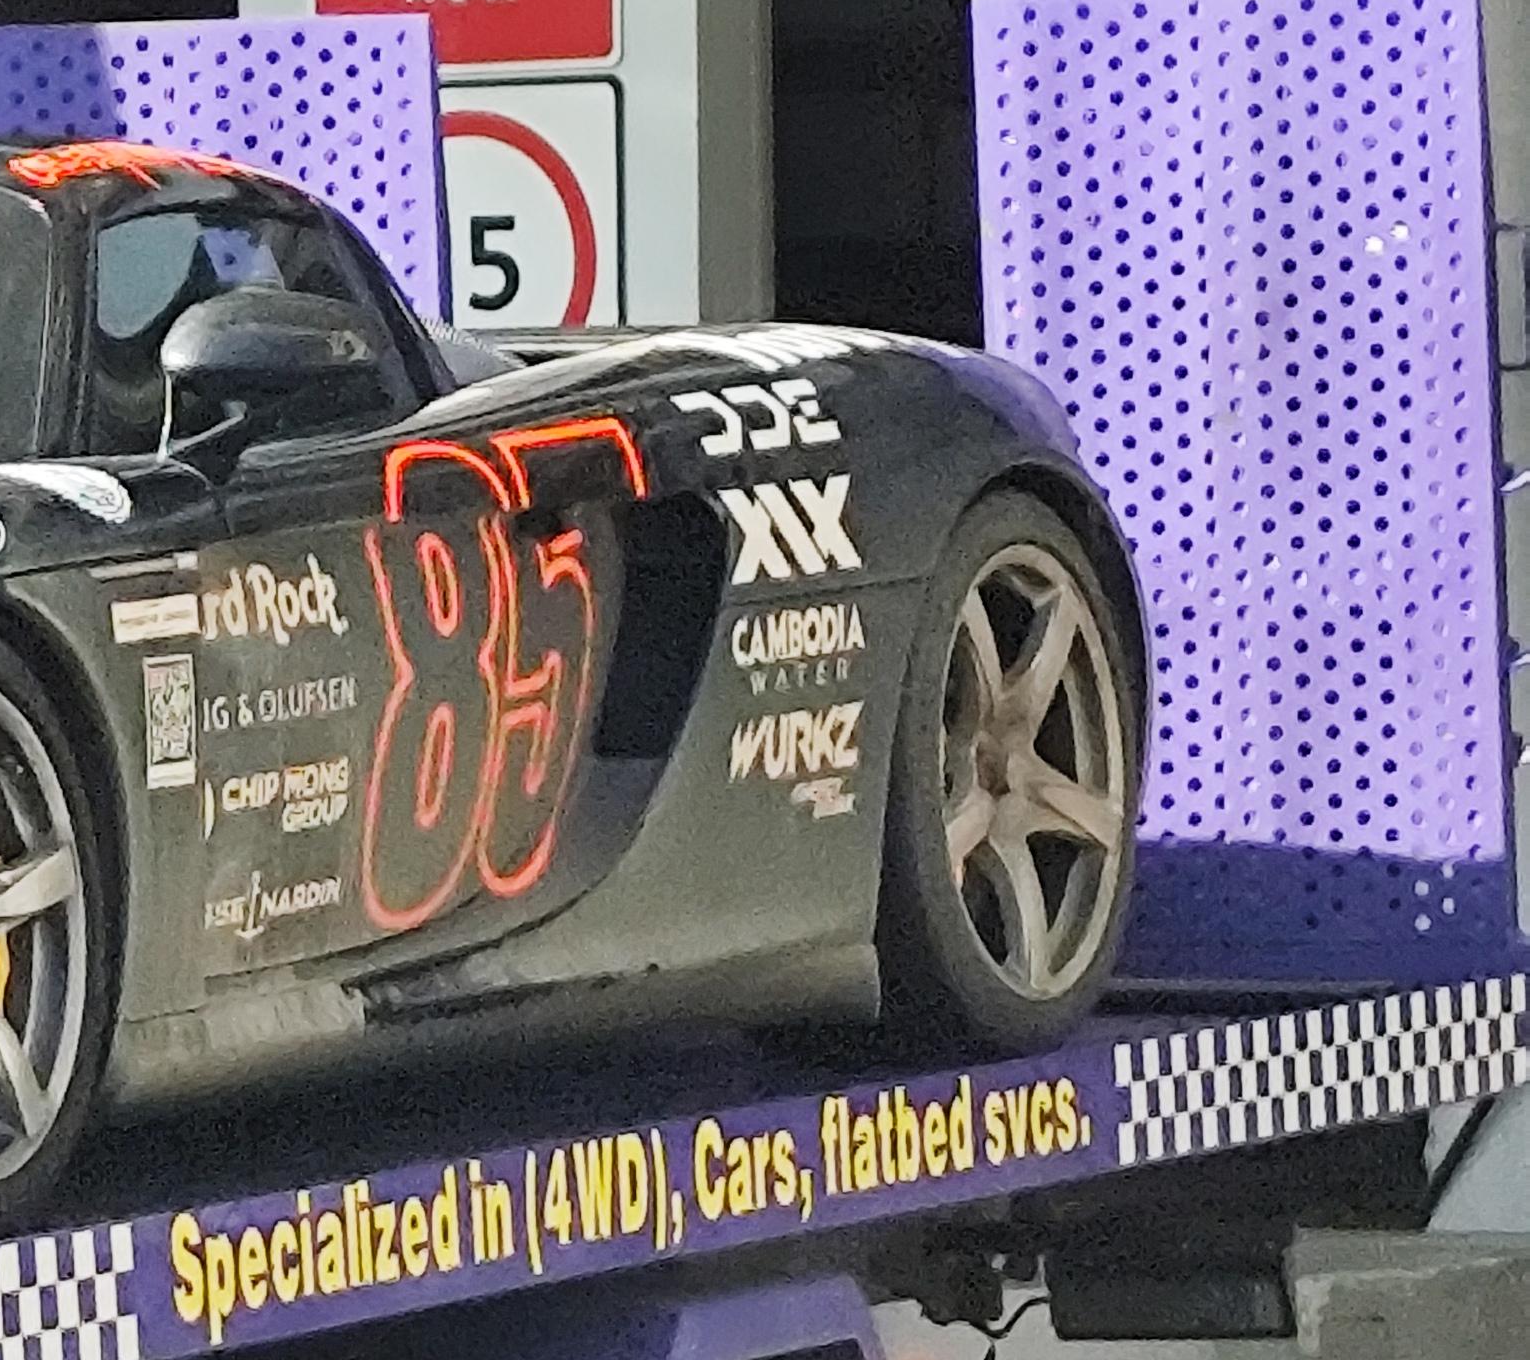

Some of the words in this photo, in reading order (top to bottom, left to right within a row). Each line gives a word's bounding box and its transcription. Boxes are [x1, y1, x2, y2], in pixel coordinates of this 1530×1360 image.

[246, 552, 350, 647] Rock
[731, 602, 866, 667] CAMBODIA
[258, 675, 358, 723] OLUFSEN
[728, 699, 865, 784] WURKZ
[222, 770, 280, 812] CHIP
[170, 1163, 463, 1347] Specialized
[468, 1158, 515, 1266] in
[693, 1116, 814, 1225] Cars,
[821, 1073, 975, 1197] flatbed
[984, 1076, 1092, 1168] svcs.
